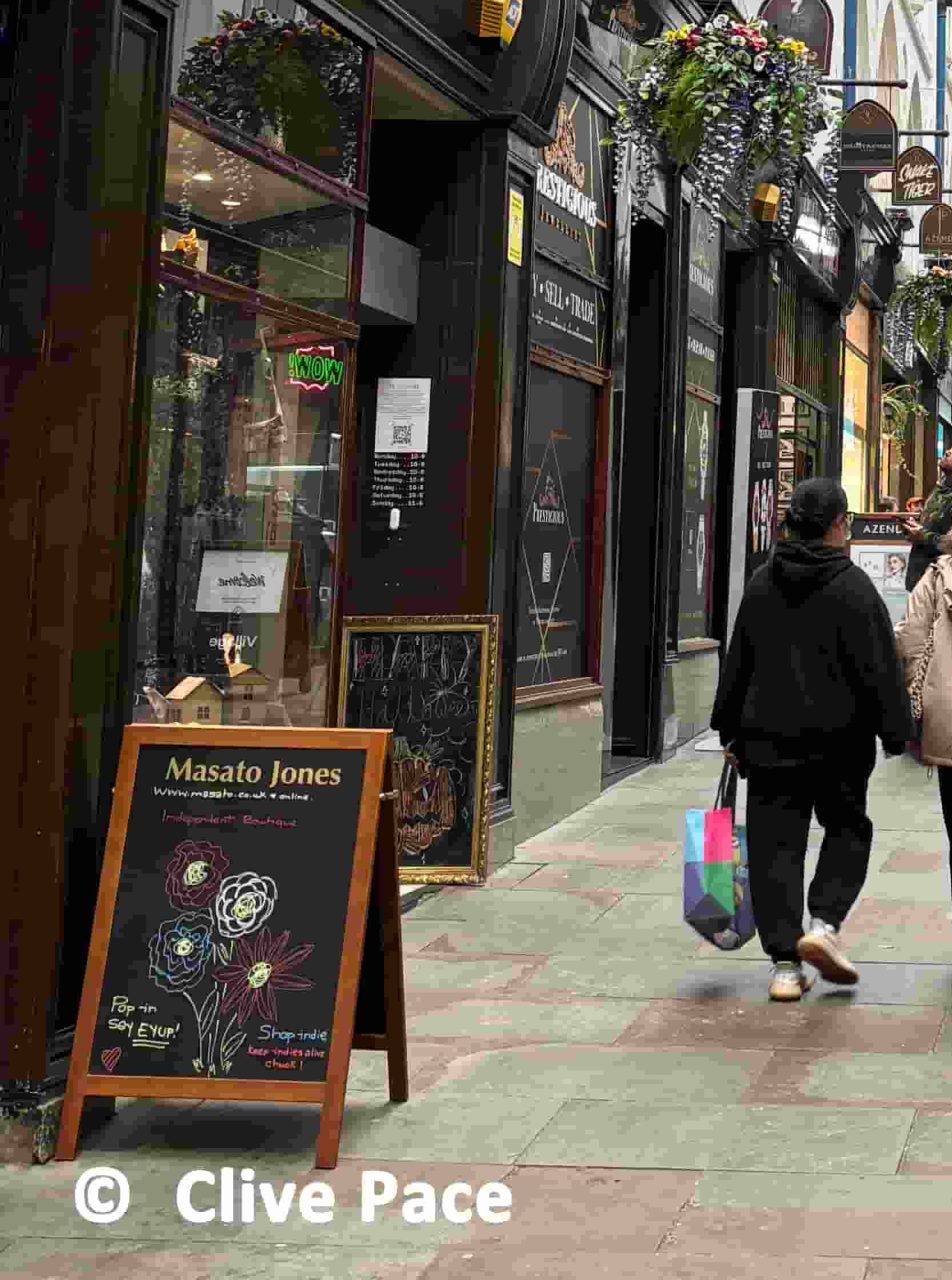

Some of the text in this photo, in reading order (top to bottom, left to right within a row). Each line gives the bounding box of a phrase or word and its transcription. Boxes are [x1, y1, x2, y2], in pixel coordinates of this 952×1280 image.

[903, 181, 935, 200] TIGER
[545, 279, 564, 310] SELL
[570, 292, 595, 325] TRADE
[165, 755, 341, 788] Masato Jones
